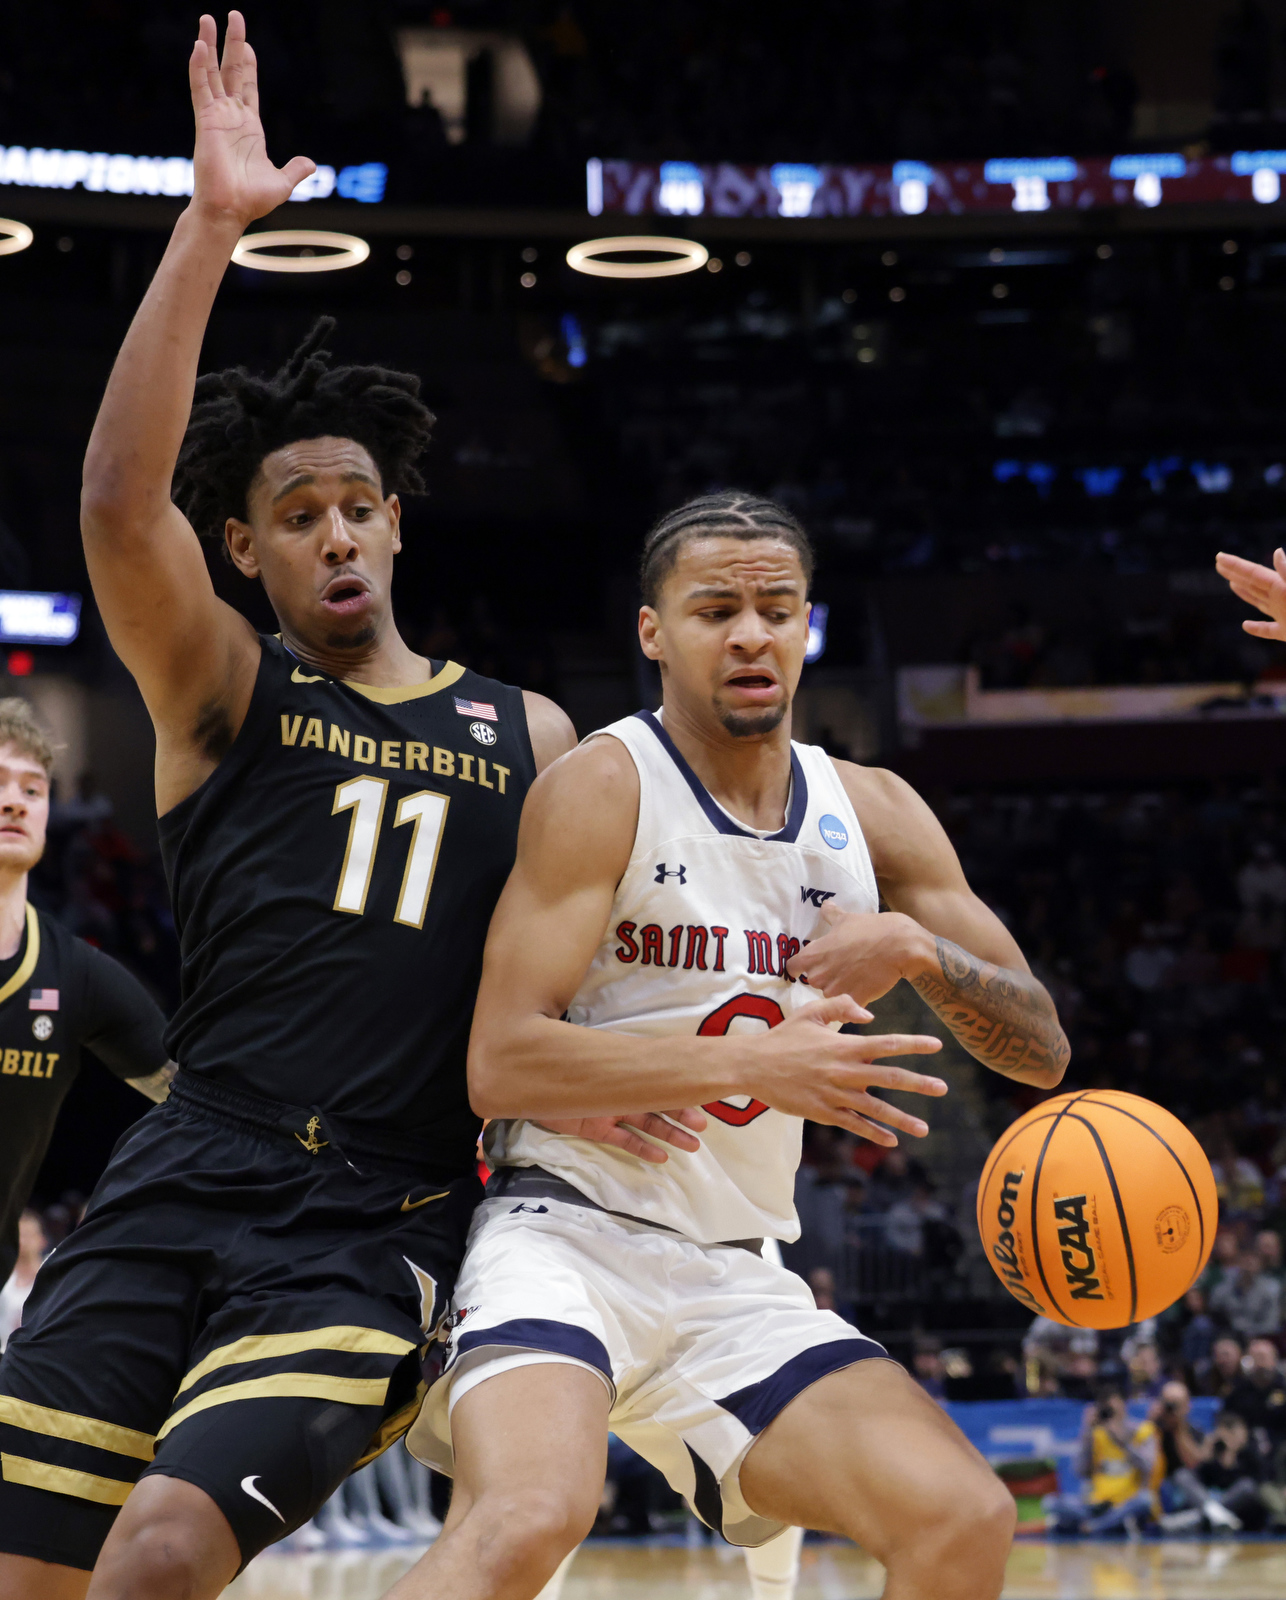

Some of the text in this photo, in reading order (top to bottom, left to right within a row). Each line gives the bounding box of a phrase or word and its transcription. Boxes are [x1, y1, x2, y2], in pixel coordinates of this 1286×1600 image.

[280, 714, 511, 795] VANDERBILT
[472, 723, 495, 743] SEC
[331, 774, 451, 930] 11
[823, 828, 847, 842] NCAA
[615, 920, 729, 972] SAINT
[0, 1048, 60, 1079] BILT
[993, 1169, 1046, 1313] Wilson
[1053, 1193, 1105, 1301] NCAA
